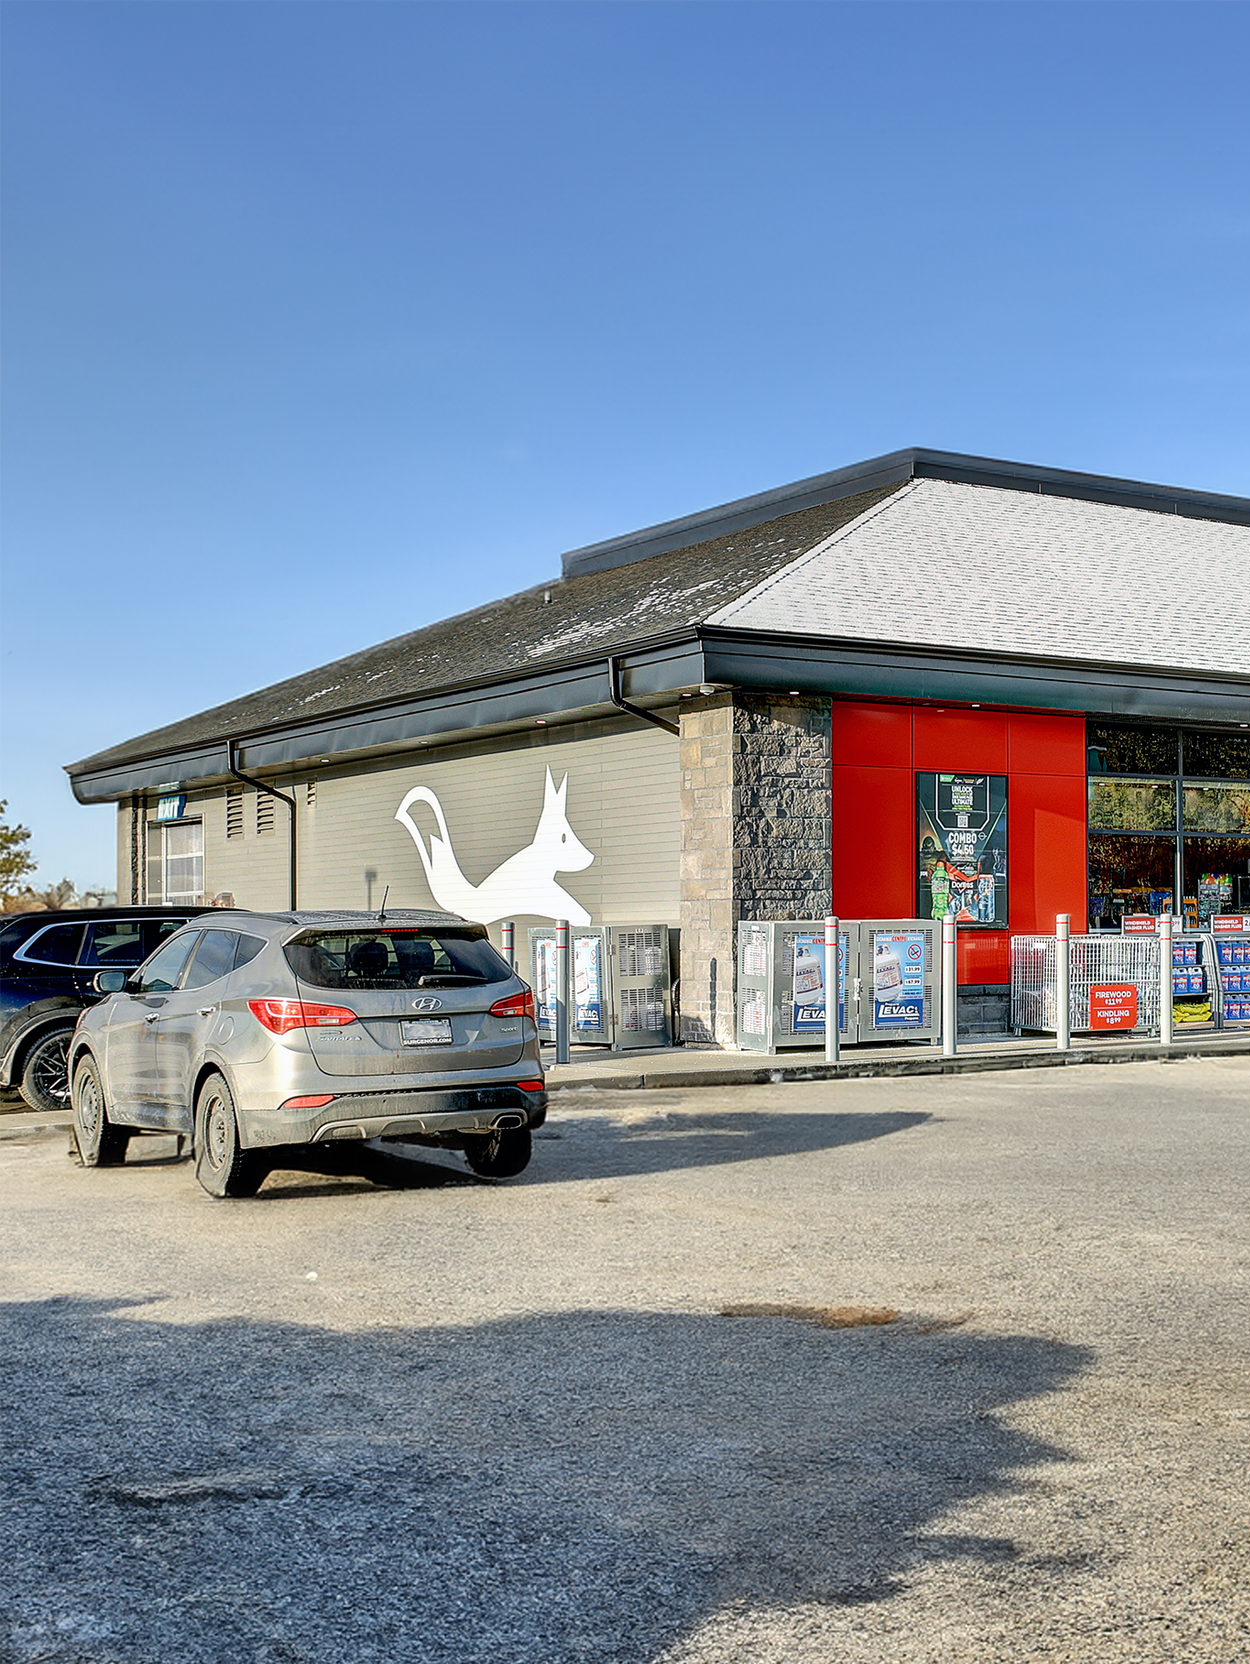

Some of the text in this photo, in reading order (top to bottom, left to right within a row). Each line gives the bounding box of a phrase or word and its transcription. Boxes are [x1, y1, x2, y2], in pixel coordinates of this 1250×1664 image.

[951, 785, 973, 793] UNLOCK
[157, 796, 180, 819] EXIT
[948, 832, 977, 844] COMBO
[951, 881, 974, 889] Doritos
[1095, 990, 1132, 999] FIREWOOD
[796, 1008, 826, 1022] LEVA
[1096, 1009, 1130, 1018] KINDLING
[403, 1037, 453, 1046] SURGENOR.COM
